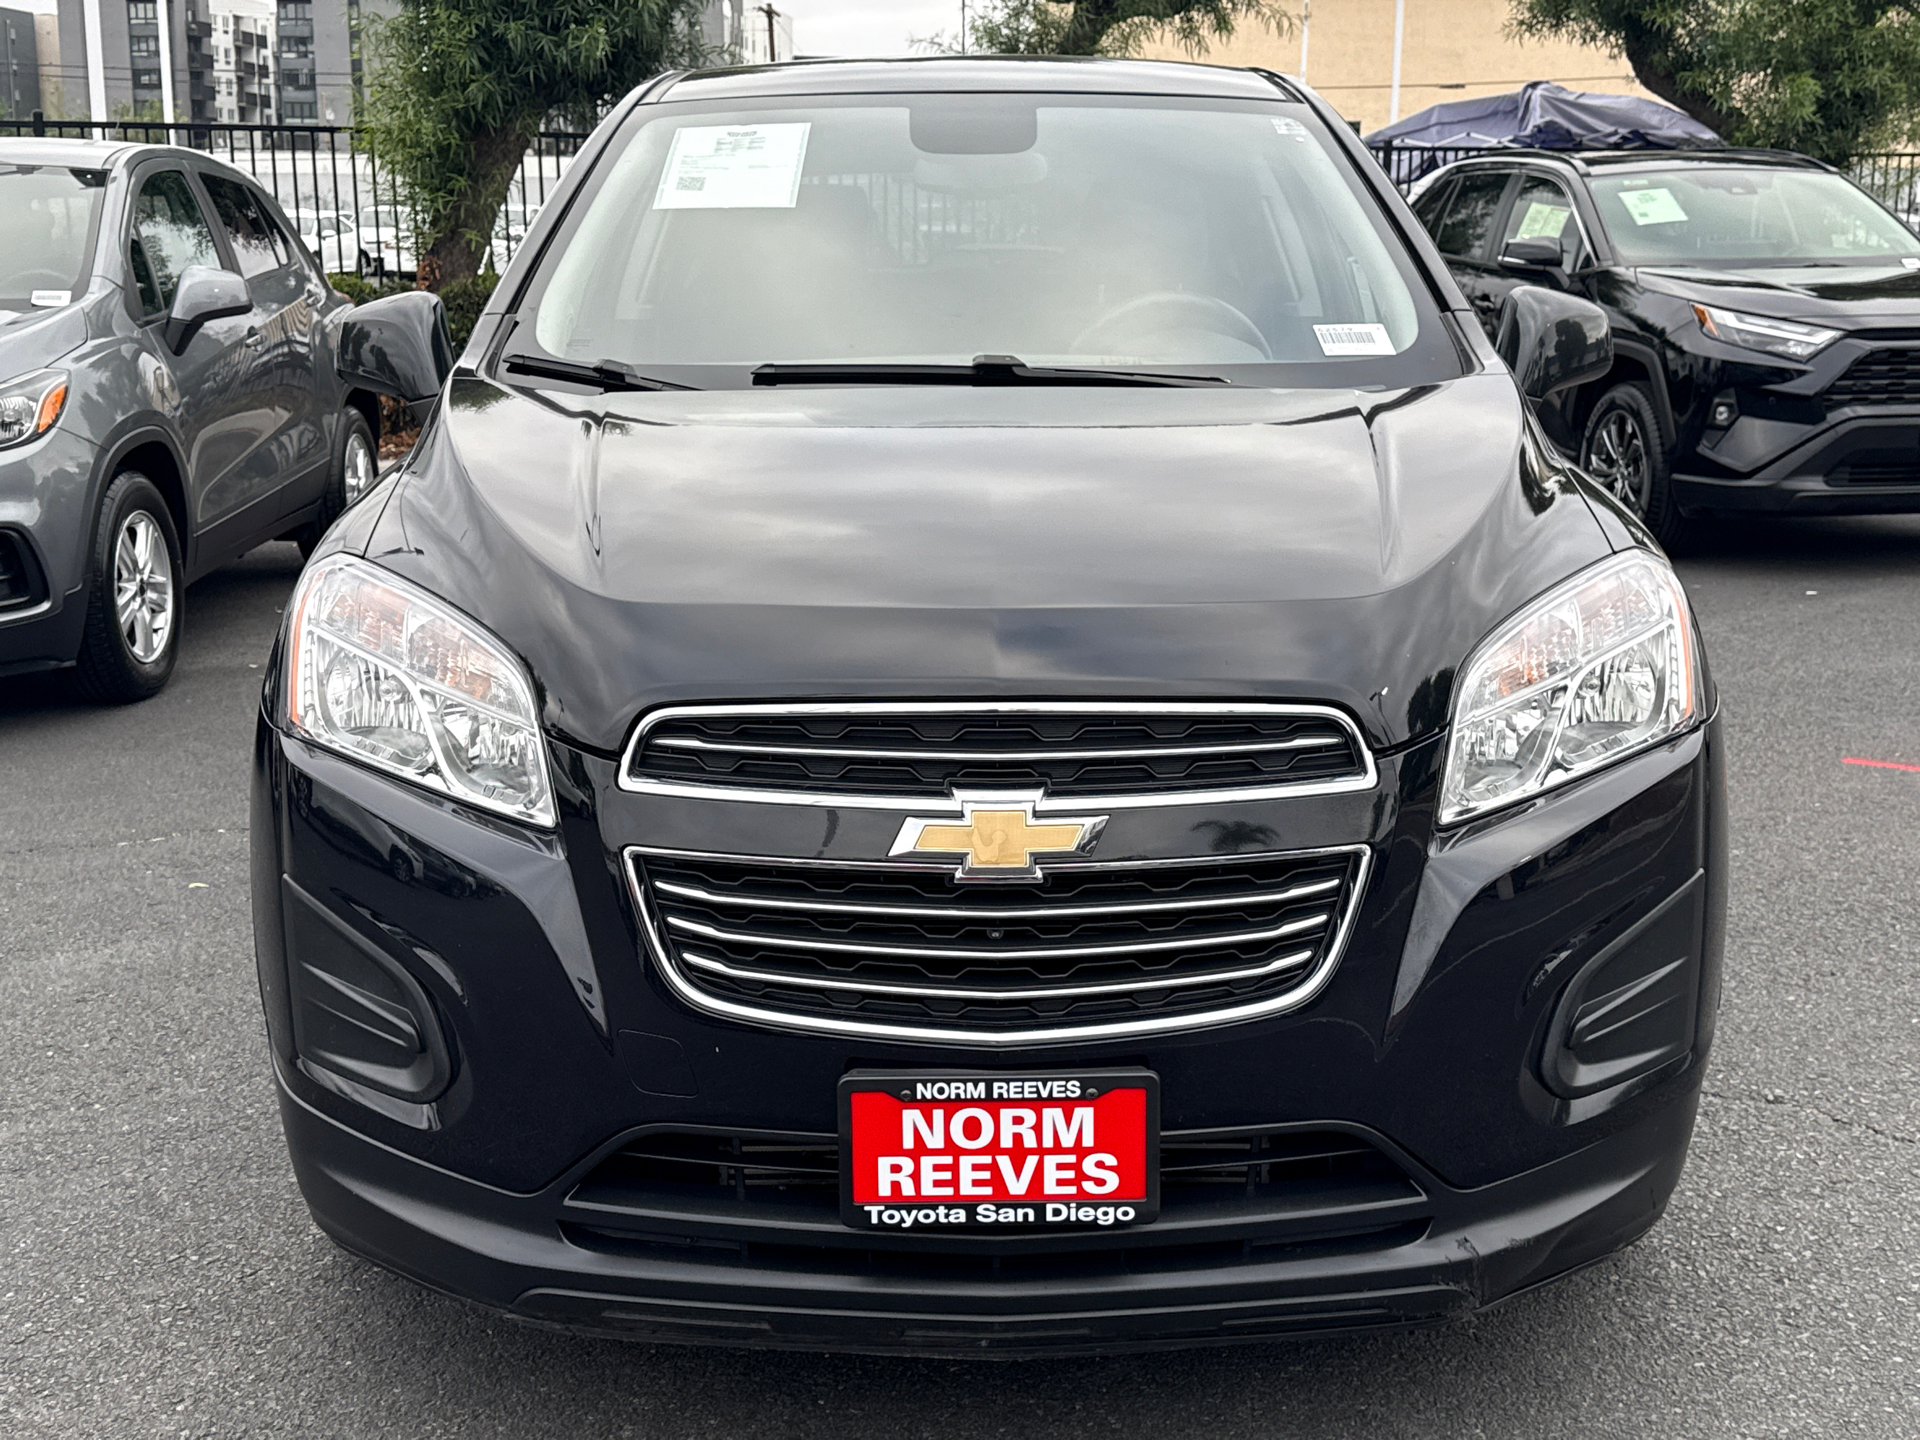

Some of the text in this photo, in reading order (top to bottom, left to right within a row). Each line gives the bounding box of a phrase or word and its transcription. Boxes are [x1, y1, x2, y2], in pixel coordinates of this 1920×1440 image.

[916, 1081, 1081, 1100] NORM REEVES
[902, 1107, 1094, 1149] NORM
[877, 1153, 1120, 1198] REEVES
[863, 1203, 1136, 1228] Toyota San Diego
